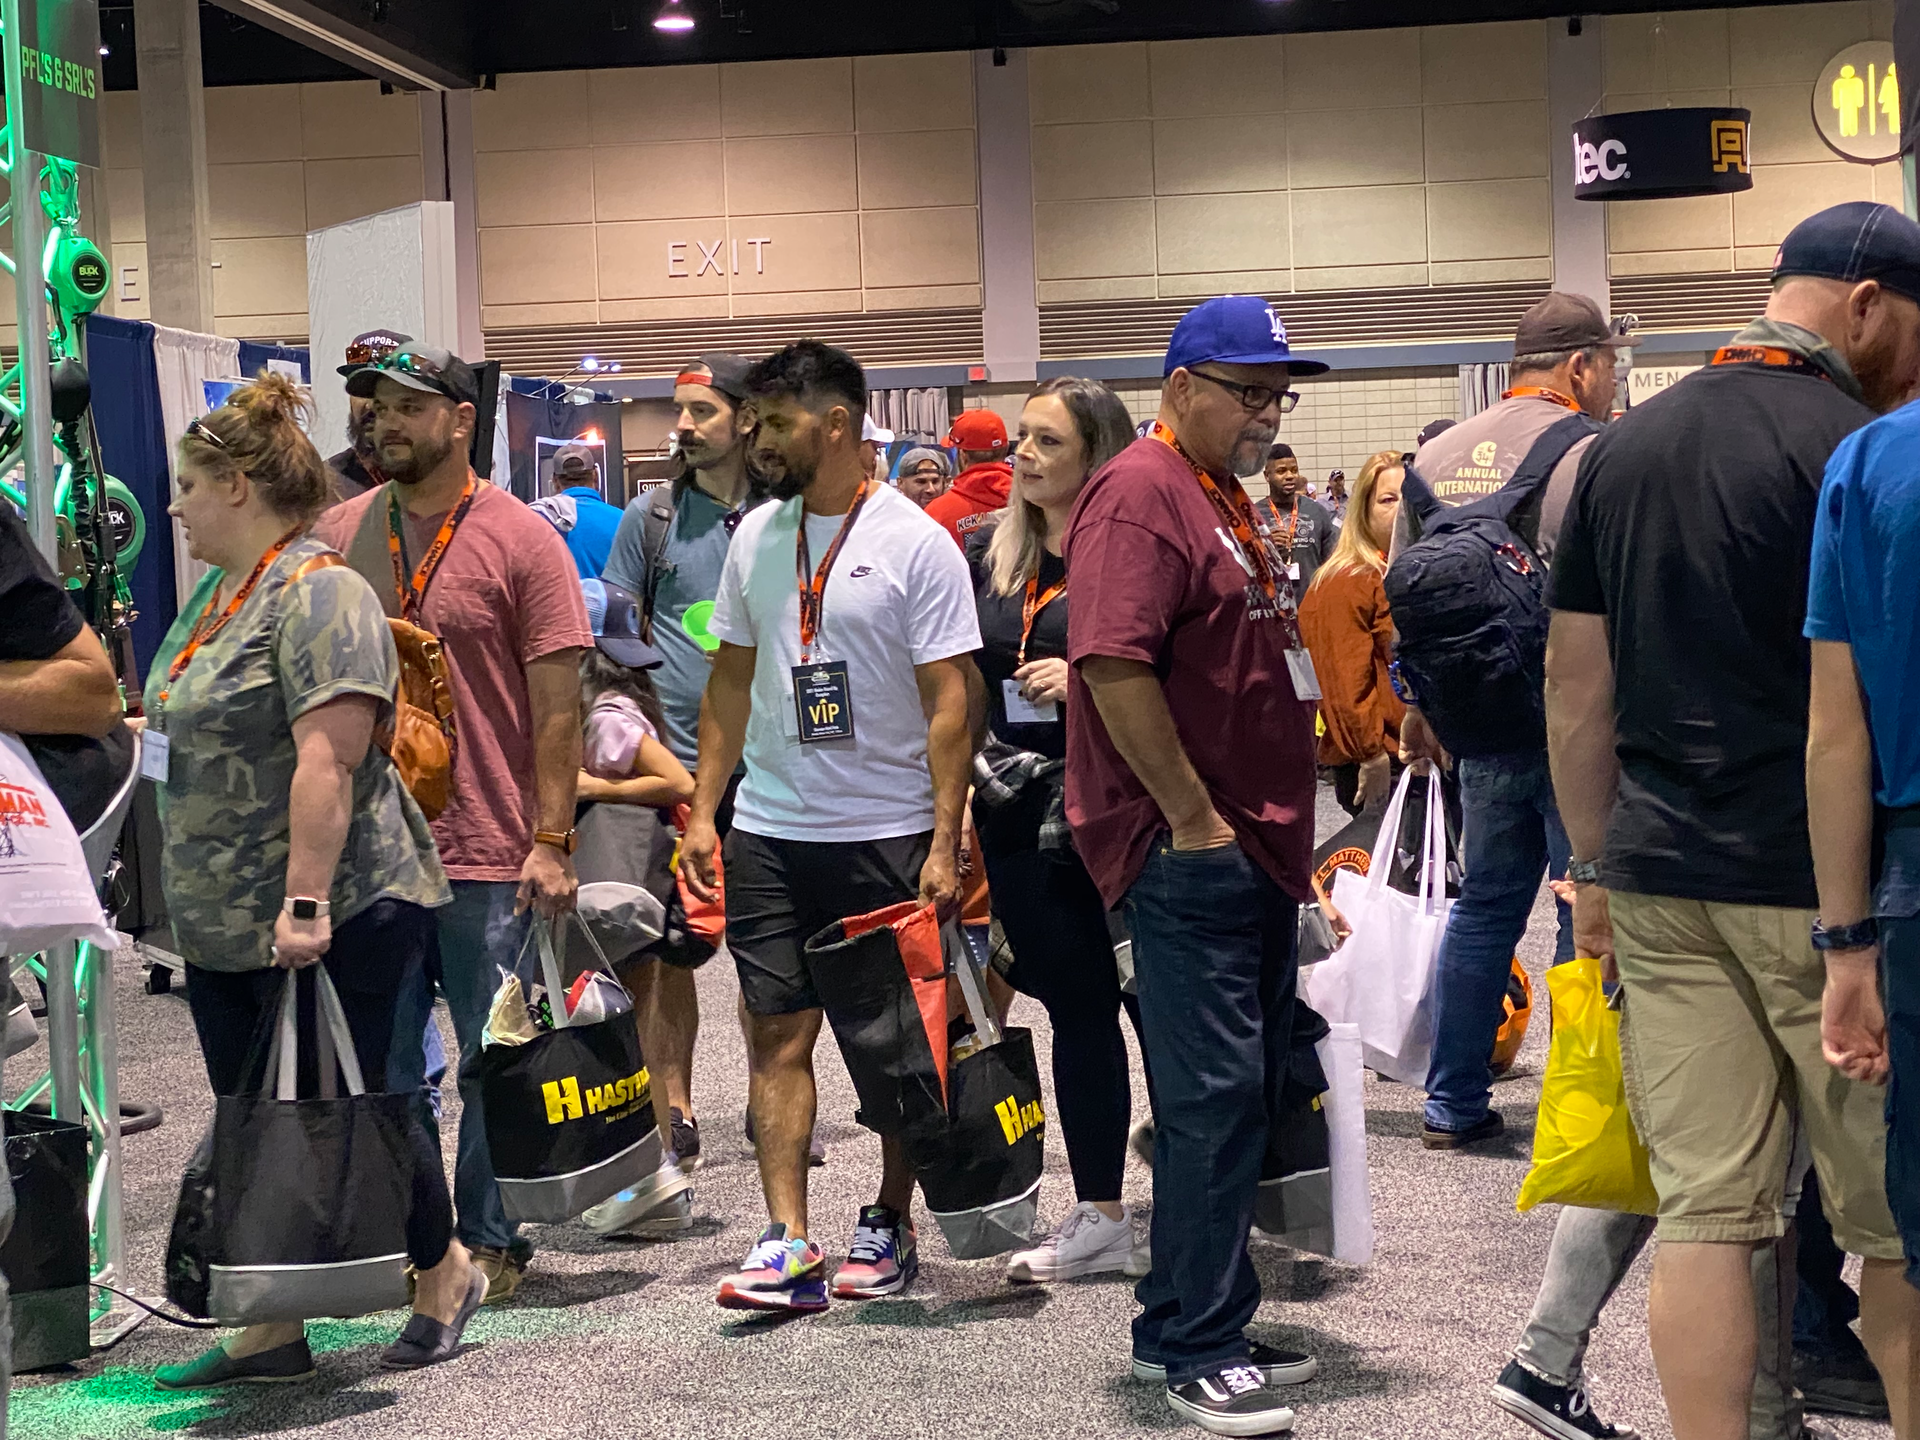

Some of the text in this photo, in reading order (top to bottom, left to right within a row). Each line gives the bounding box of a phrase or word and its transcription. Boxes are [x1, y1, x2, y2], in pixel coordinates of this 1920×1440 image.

[21, 45, 96, 100] PFL'S & SRL'S
[667, 237, 772, 278] EXIT
[1455, 467, 1502, 479] ANNUAL
[1434, 480, 1507, 498] INTERNATIO
[956, 512, 980, 532] KCK
[808, 702, 840, 725] VIP
[1020, 1099, 1045, 1133] HA
